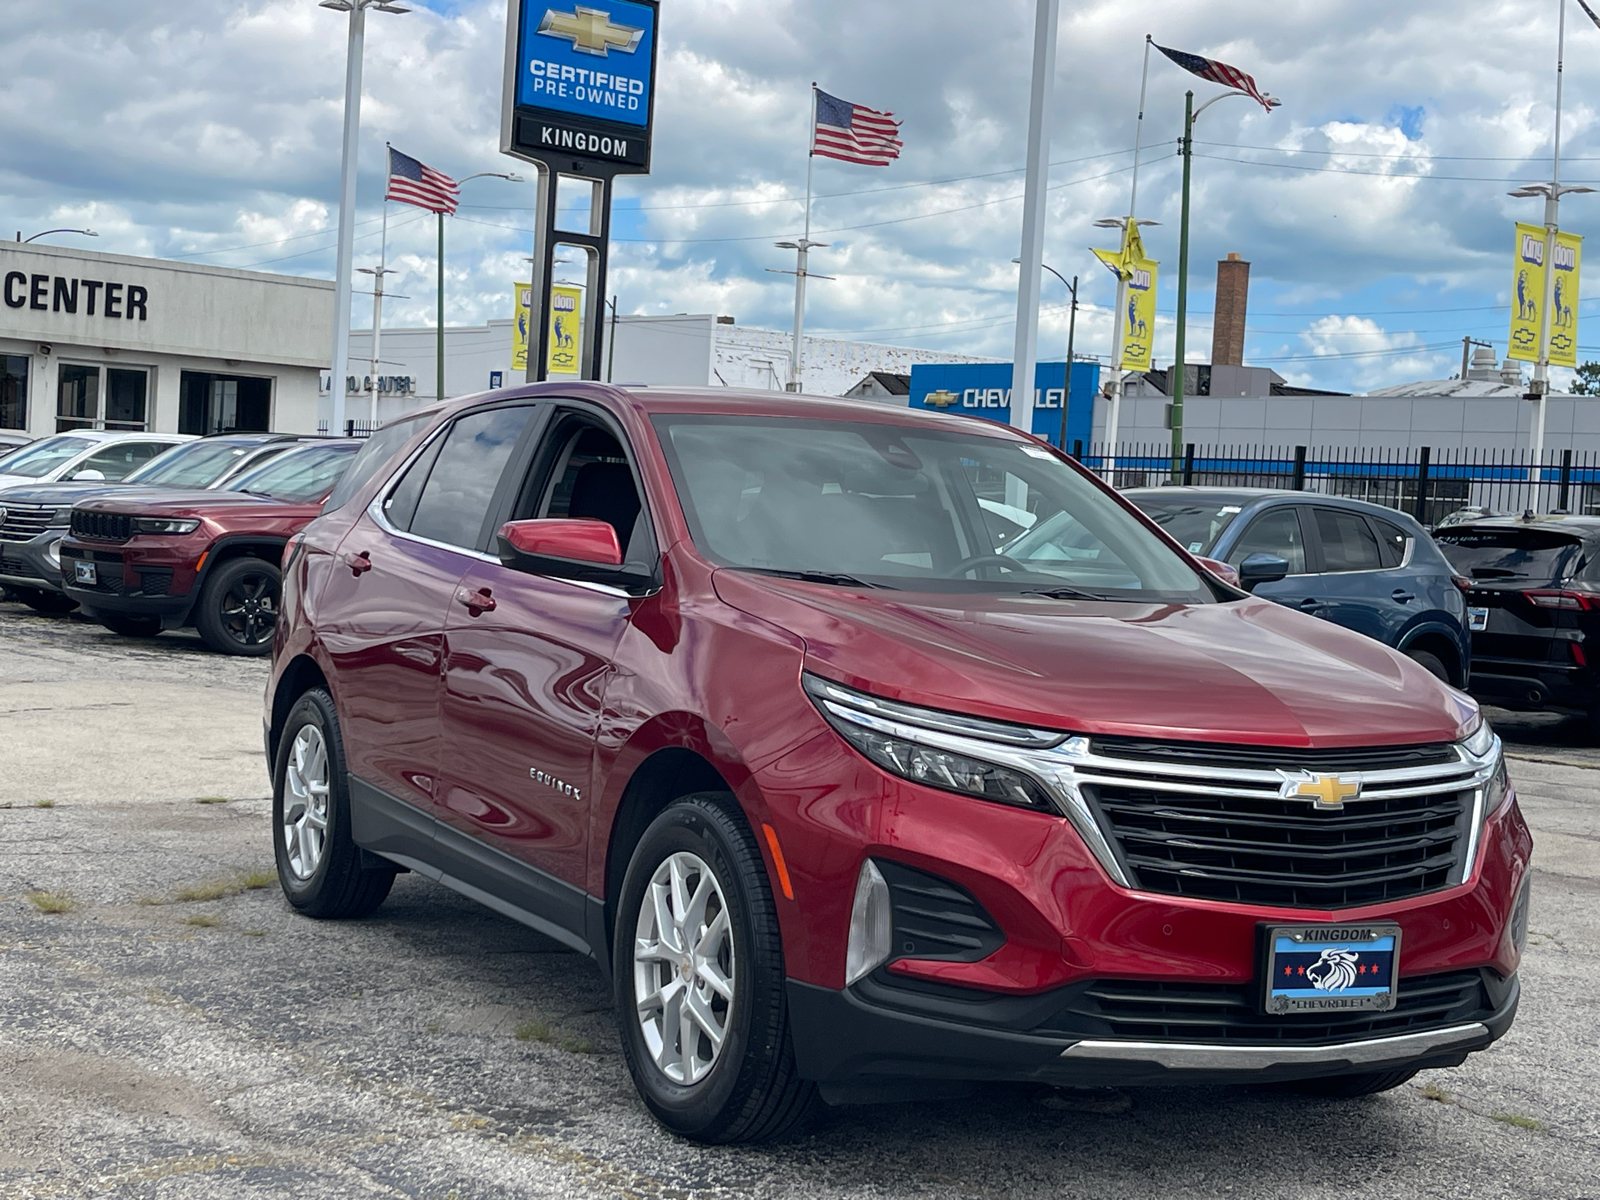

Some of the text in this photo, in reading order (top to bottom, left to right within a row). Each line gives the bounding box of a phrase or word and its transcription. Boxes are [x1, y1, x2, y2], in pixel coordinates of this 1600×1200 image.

[530, 59, 644, 95] CERTIFIED
[533, 78, 639, 111] PRE-OWNED
[541, 126, 627, 157] KINGDOM
[1521, 234, 1544, 265] King
[1554, 243, 1575, 269] dom
[4, 271, 148, 321] CENTER
[553, 293, 575, 310] dom
[364, 376, 414, 392] CNTER
[963, 388, 1071, 408] CHEVLET
[529, 767, 581, 801] EQUINOX
[1303, 929, 1372, 941] KINGDOM
[1296, 998, 1366, 1010] CHEVROLET
